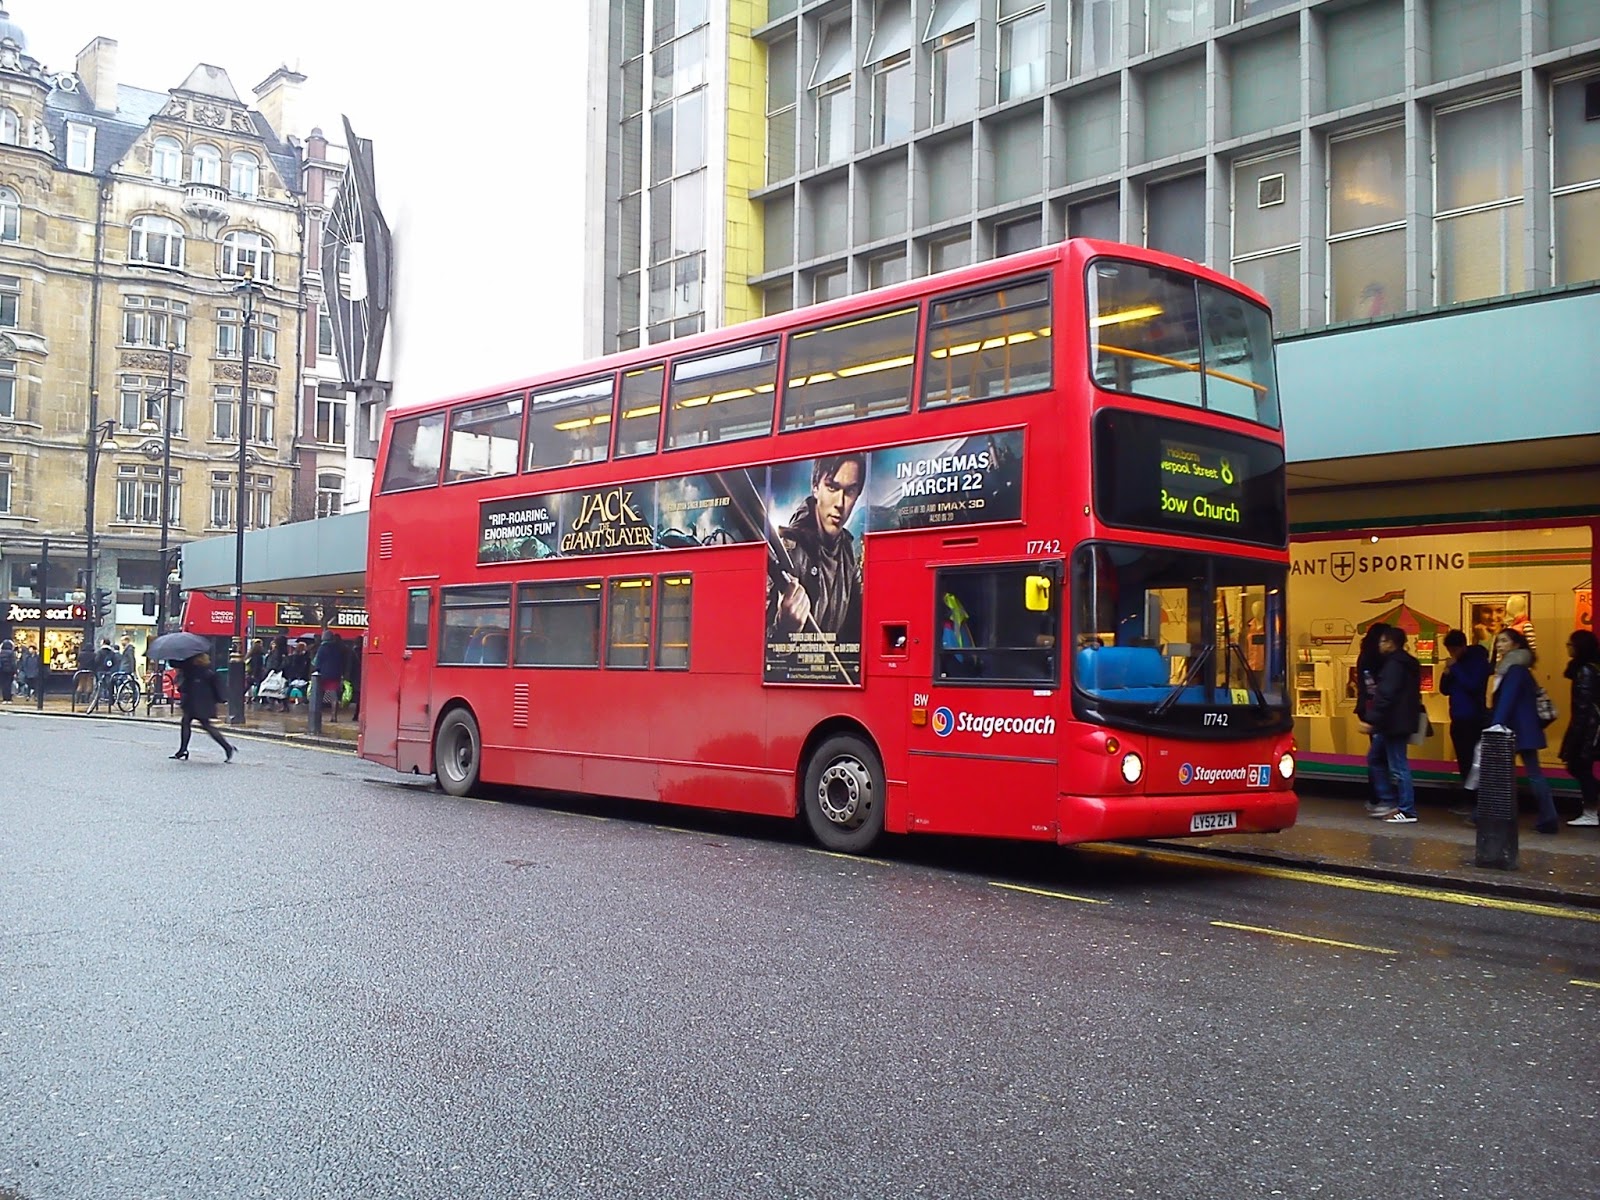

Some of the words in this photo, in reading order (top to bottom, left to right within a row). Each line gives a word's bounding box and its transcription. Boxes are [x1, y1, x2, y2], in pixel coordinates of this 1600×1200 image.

[896, 462, 912, 479] IN
[915, 451, 989, 477] CINEMAS
[1192, 463, 1219, 479] Street
[1220, 455, 1234, 485] 8
[902, 475, 959, 497] MARCH
[961, 472, 983, 491] 22
[572, 486, 643, 530] JACK
[937, 501, 967, 512] IMAX
[968, 499, 985, 509] 3D
[1193, 495, 1240, 523] Church
[484, 524, 533, 541] ENORMOUS
[599, 522, 611, 531] THE
[561, 530, 604, 552] GIANT
[605, 526, 655, 548] SLAYER
[1027, 539, 1061, 554] 17742
[1291, 559, 1328, 576] ANT
[1359, 552, 1465, 573] SPORTING
[338, 613, 369, 626] BROK
[914, 693, 929, 707] BW
[956, 711, 1056, 738] Stagecoach
[1203, 713, 1229, 726] 17742
[1194, 766, 1247, 784] Stagecoach
[1193, 814, 1216, 830] LY52
[1217, 813, 1234, 827] ZFA
